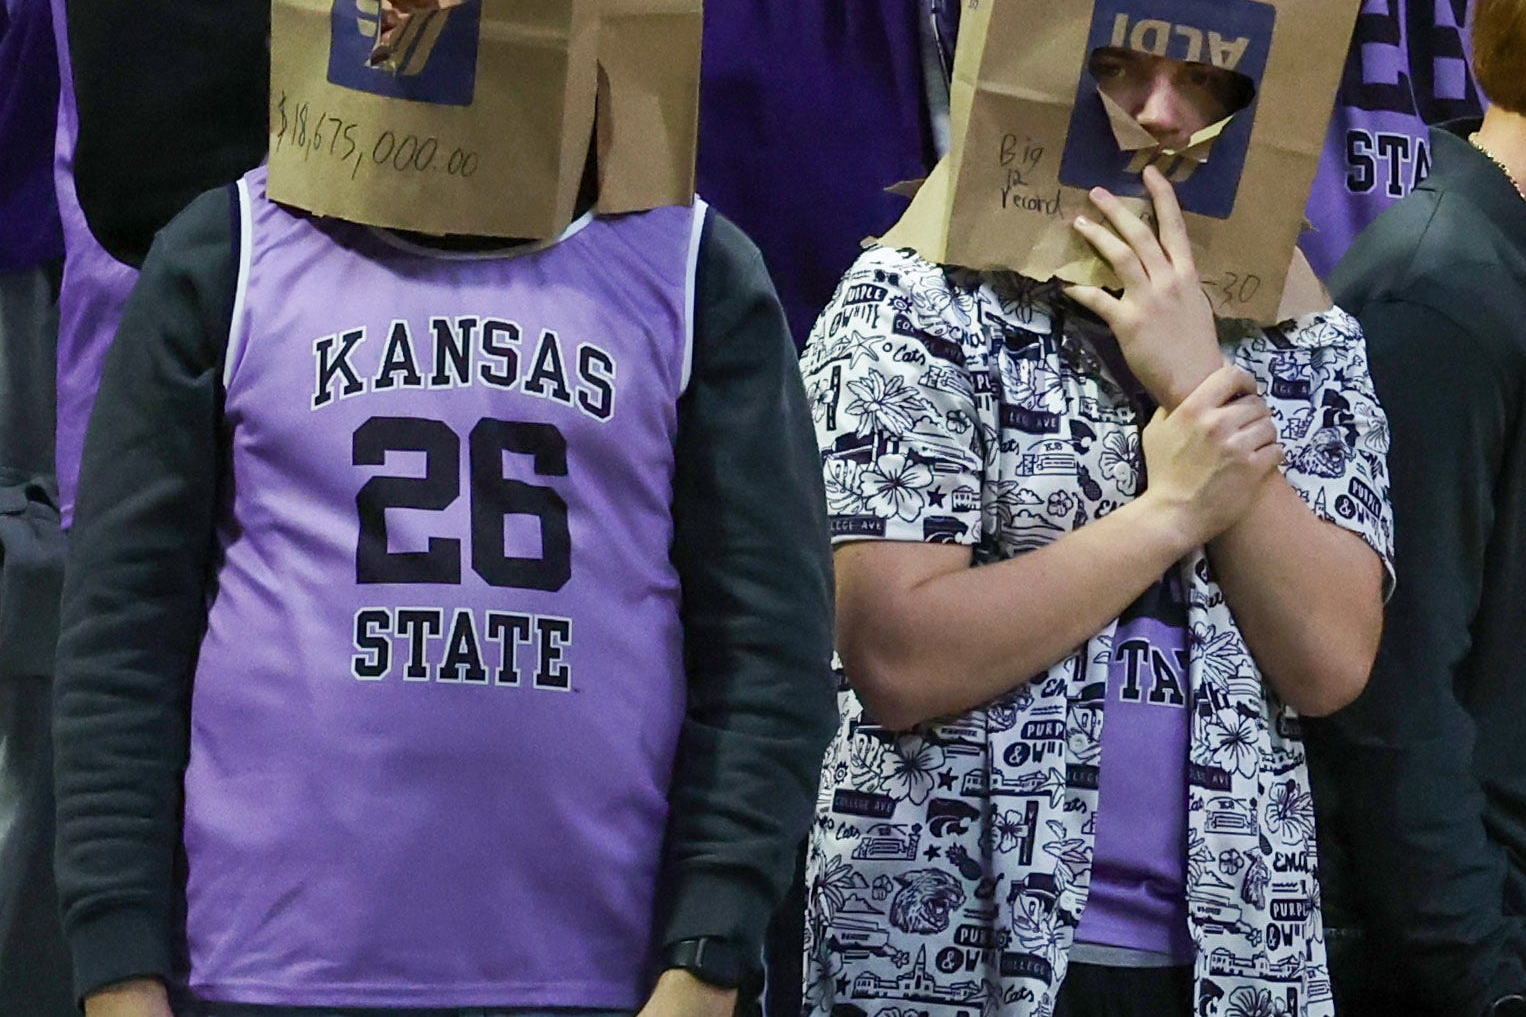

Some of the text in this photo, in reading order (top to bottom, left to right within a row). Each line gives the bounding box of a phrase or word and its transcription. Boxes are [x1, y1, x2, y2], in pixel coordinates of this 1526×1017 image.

[1112, 12, 1250, 70] ALDI
[276, 90, 479, 180] $18,675,000.00
[1000, 134, 1044, 172] Big
[1346, 129, 1433, 199] STA
[311, 315, 617, 422] KANSAS
[893, 343, 926, 366] Cats
[351, 415, 573, 592] 26
[351, 605, 574, 692] STATE
[1026, 723, 1064, 737] PURP
[1004, 984, 1034, 1004] Cats
